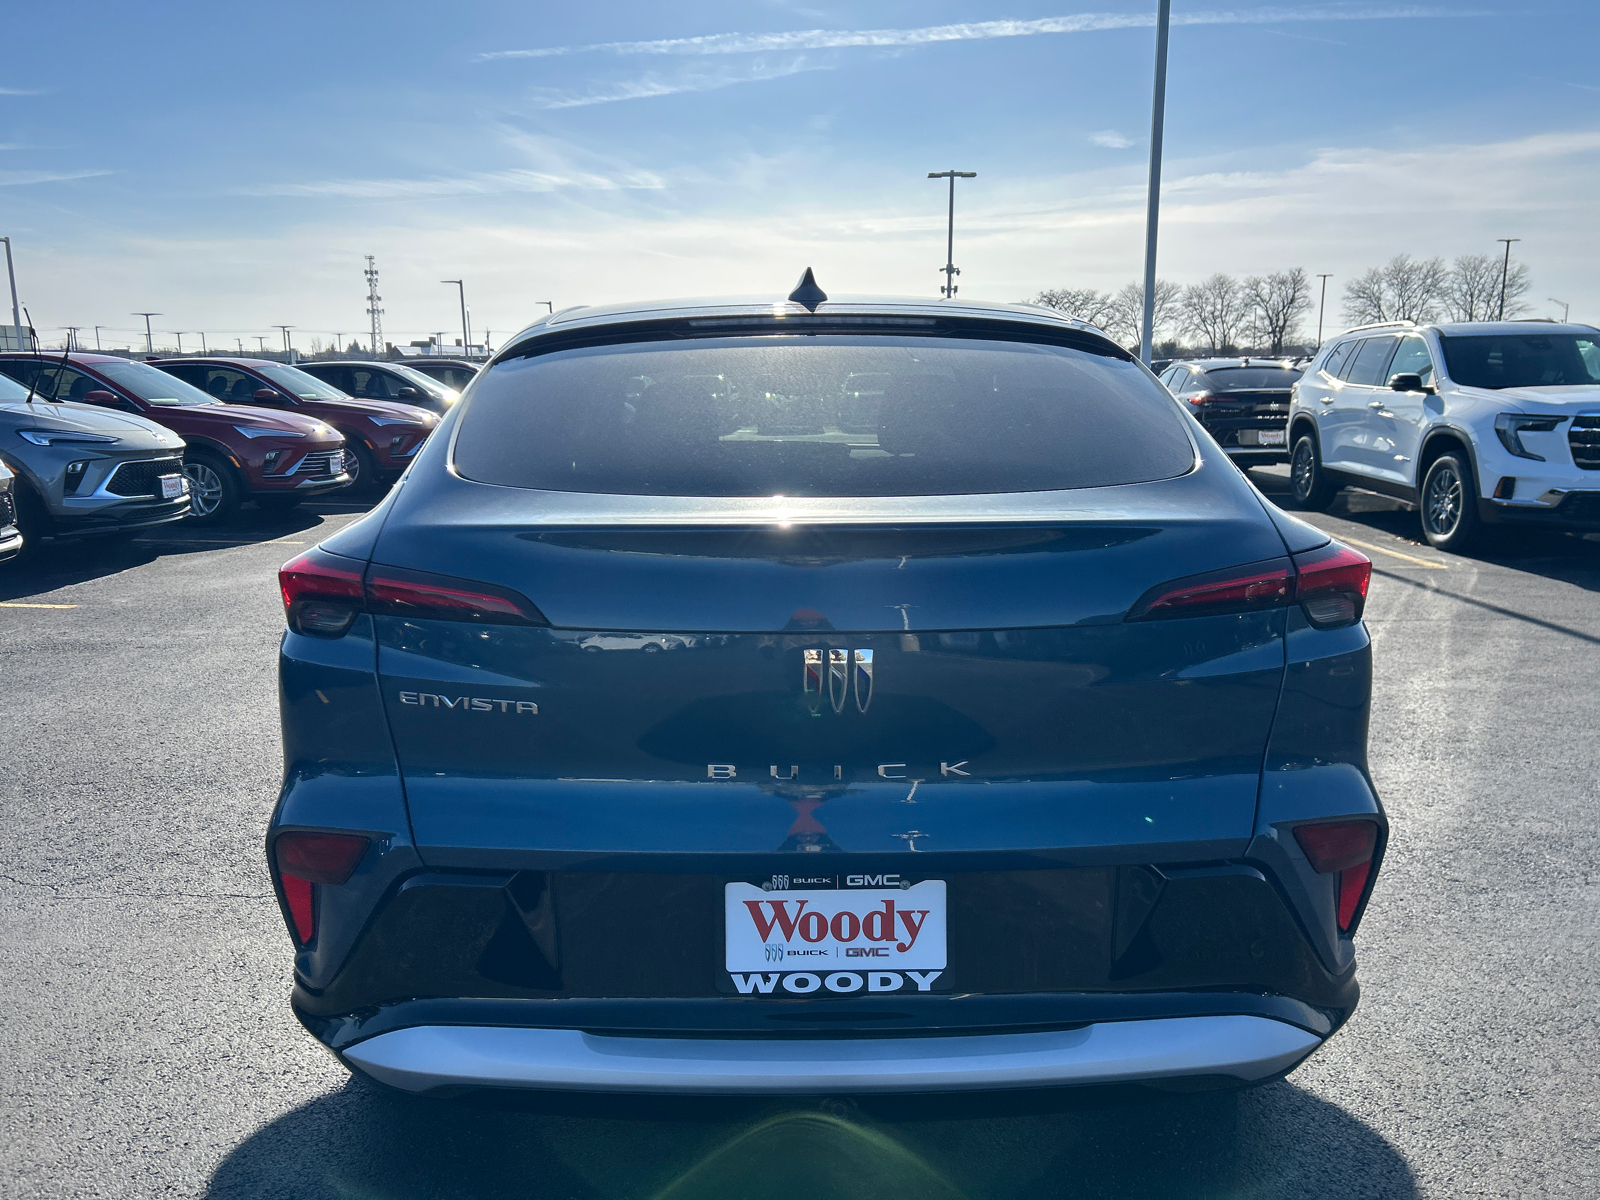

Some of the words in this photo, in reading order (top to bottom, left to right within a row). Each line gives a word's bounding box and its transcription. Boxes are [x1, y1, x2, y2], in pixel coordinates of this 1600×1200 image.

[707, 761, 971, 780] BUICK
[846, 875, 901, 886] GMC
[742, 899, 930, 953] Woody
[845, 947, 890, 957] GMC
[730, 971, 943, 994] WOODY
